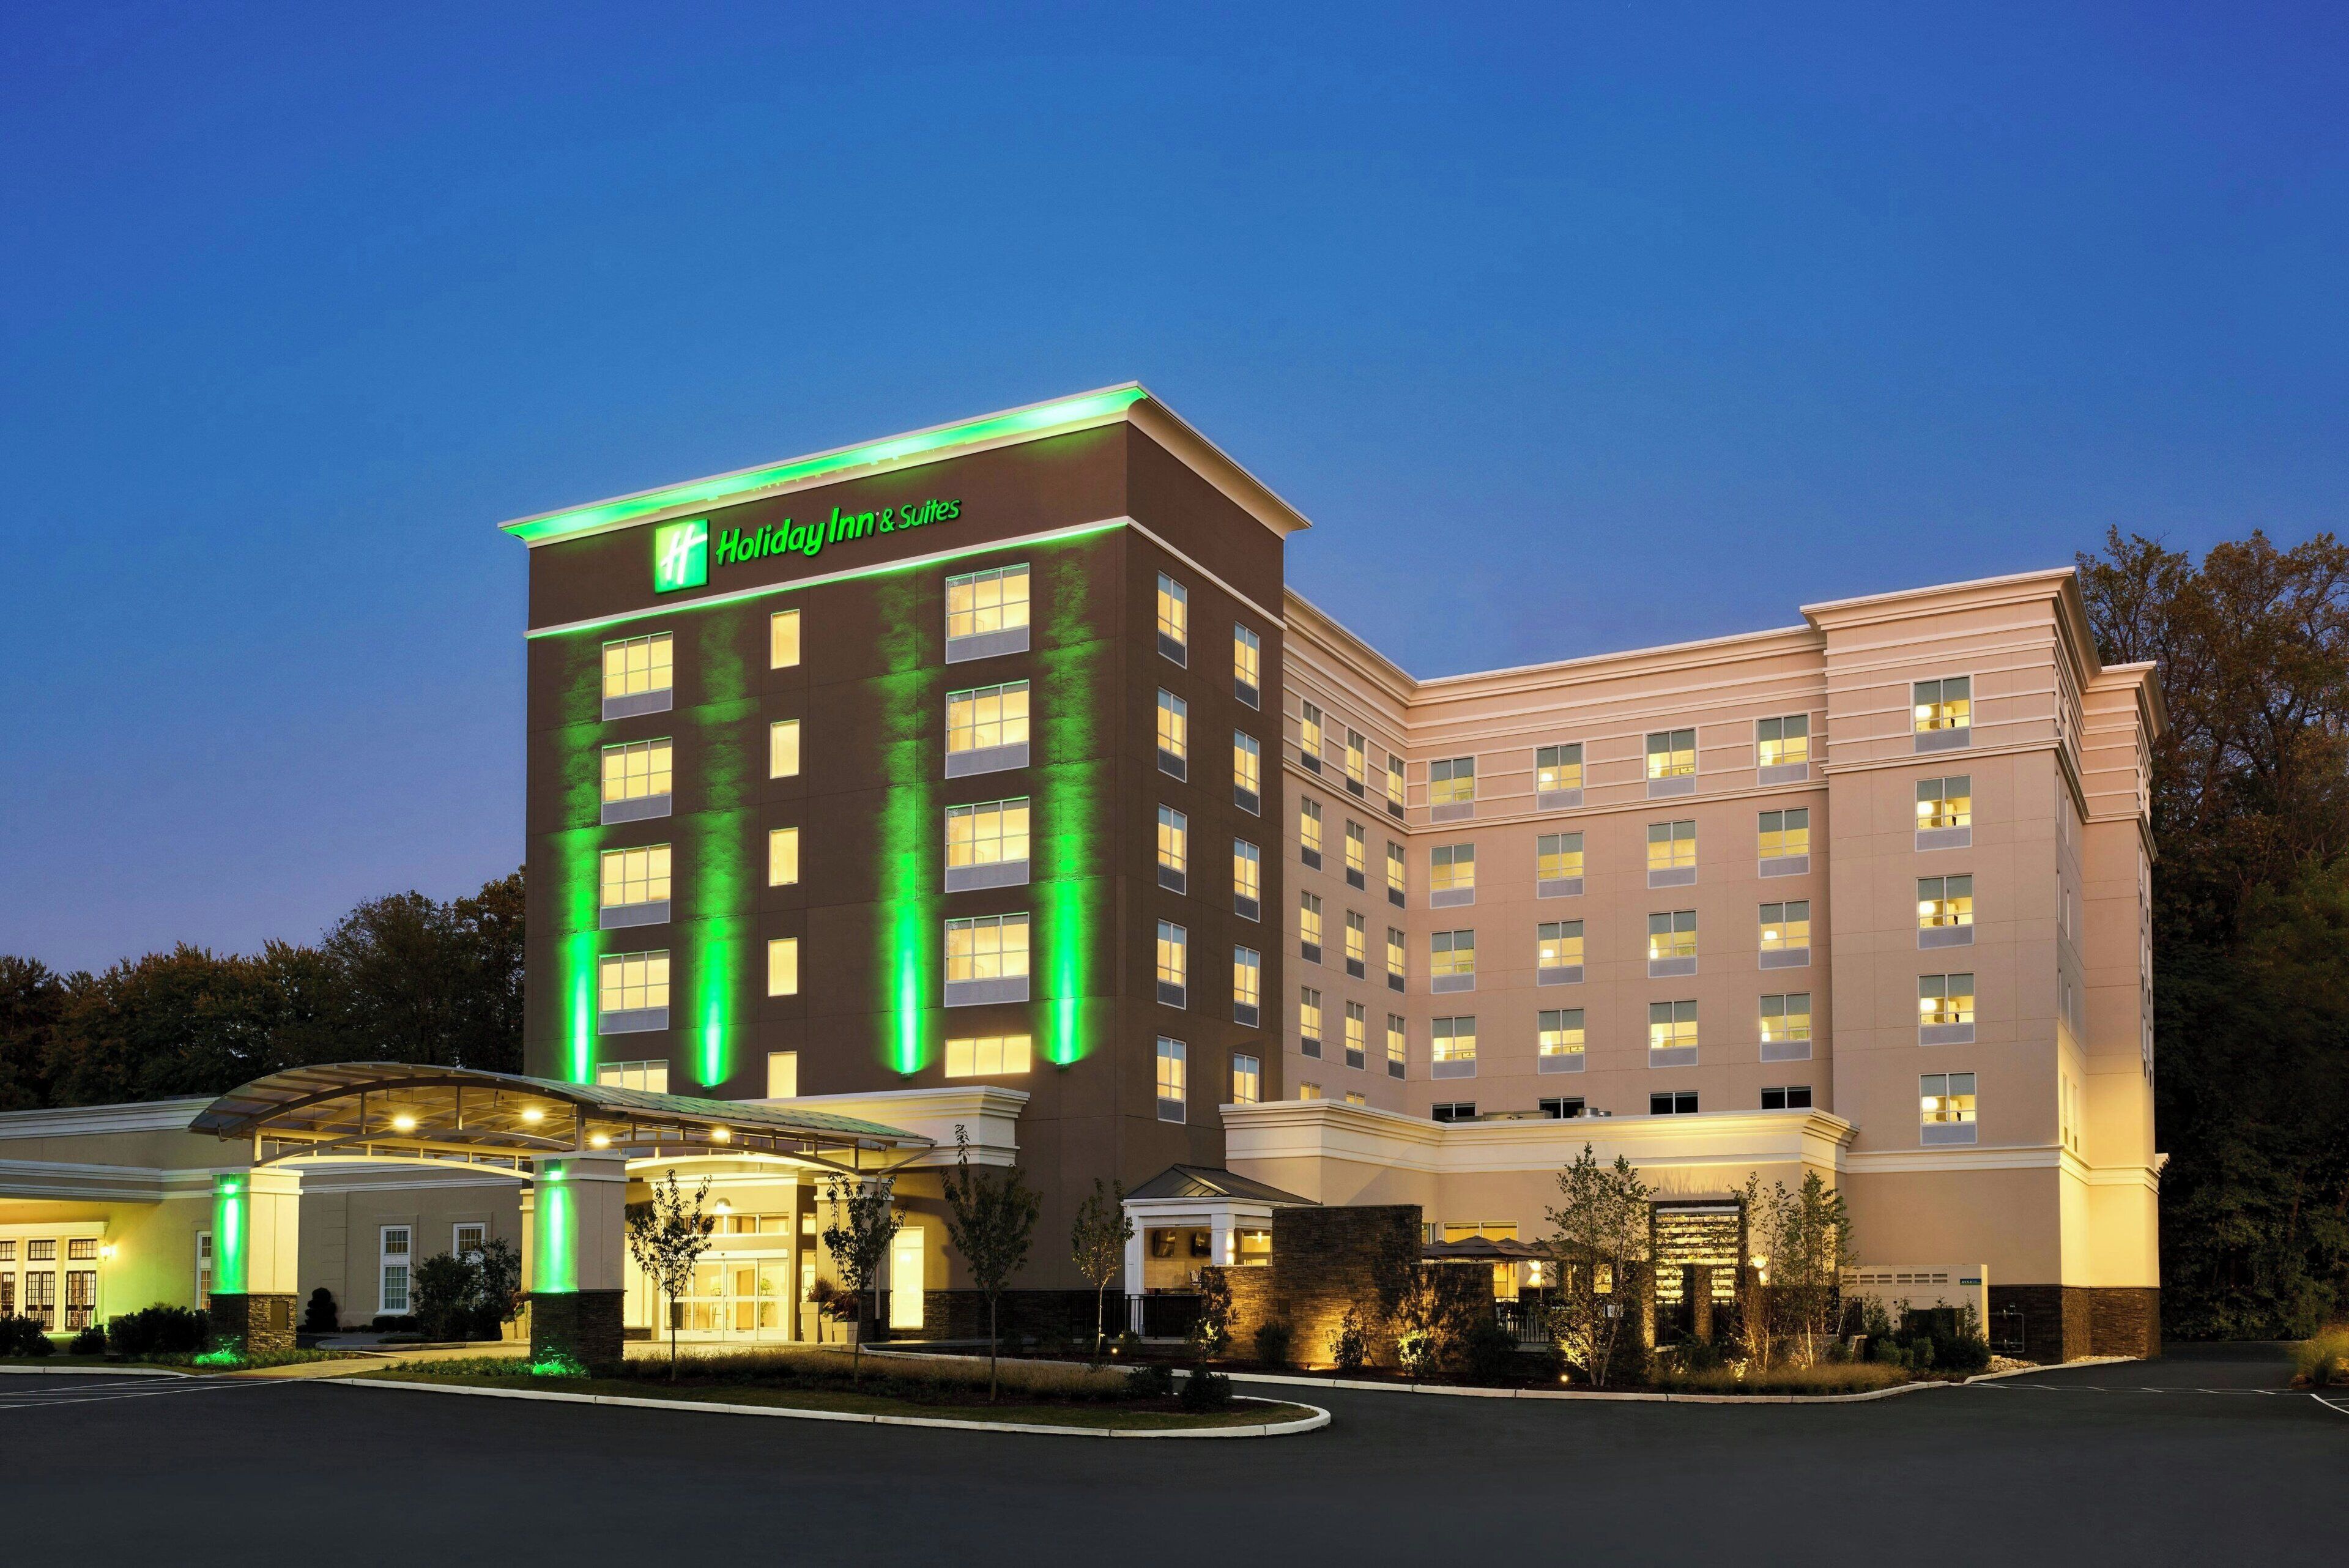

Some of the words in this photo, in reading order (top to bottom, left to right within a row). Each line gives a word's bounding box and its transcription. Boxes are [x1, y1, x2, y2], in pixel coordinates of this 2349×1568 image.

[715, 518, 826, 565] Holiday
[828, 507, 875, 544] Inn
[879, 508, 896, 533] &
[898, 499, 962, 529] Suites
